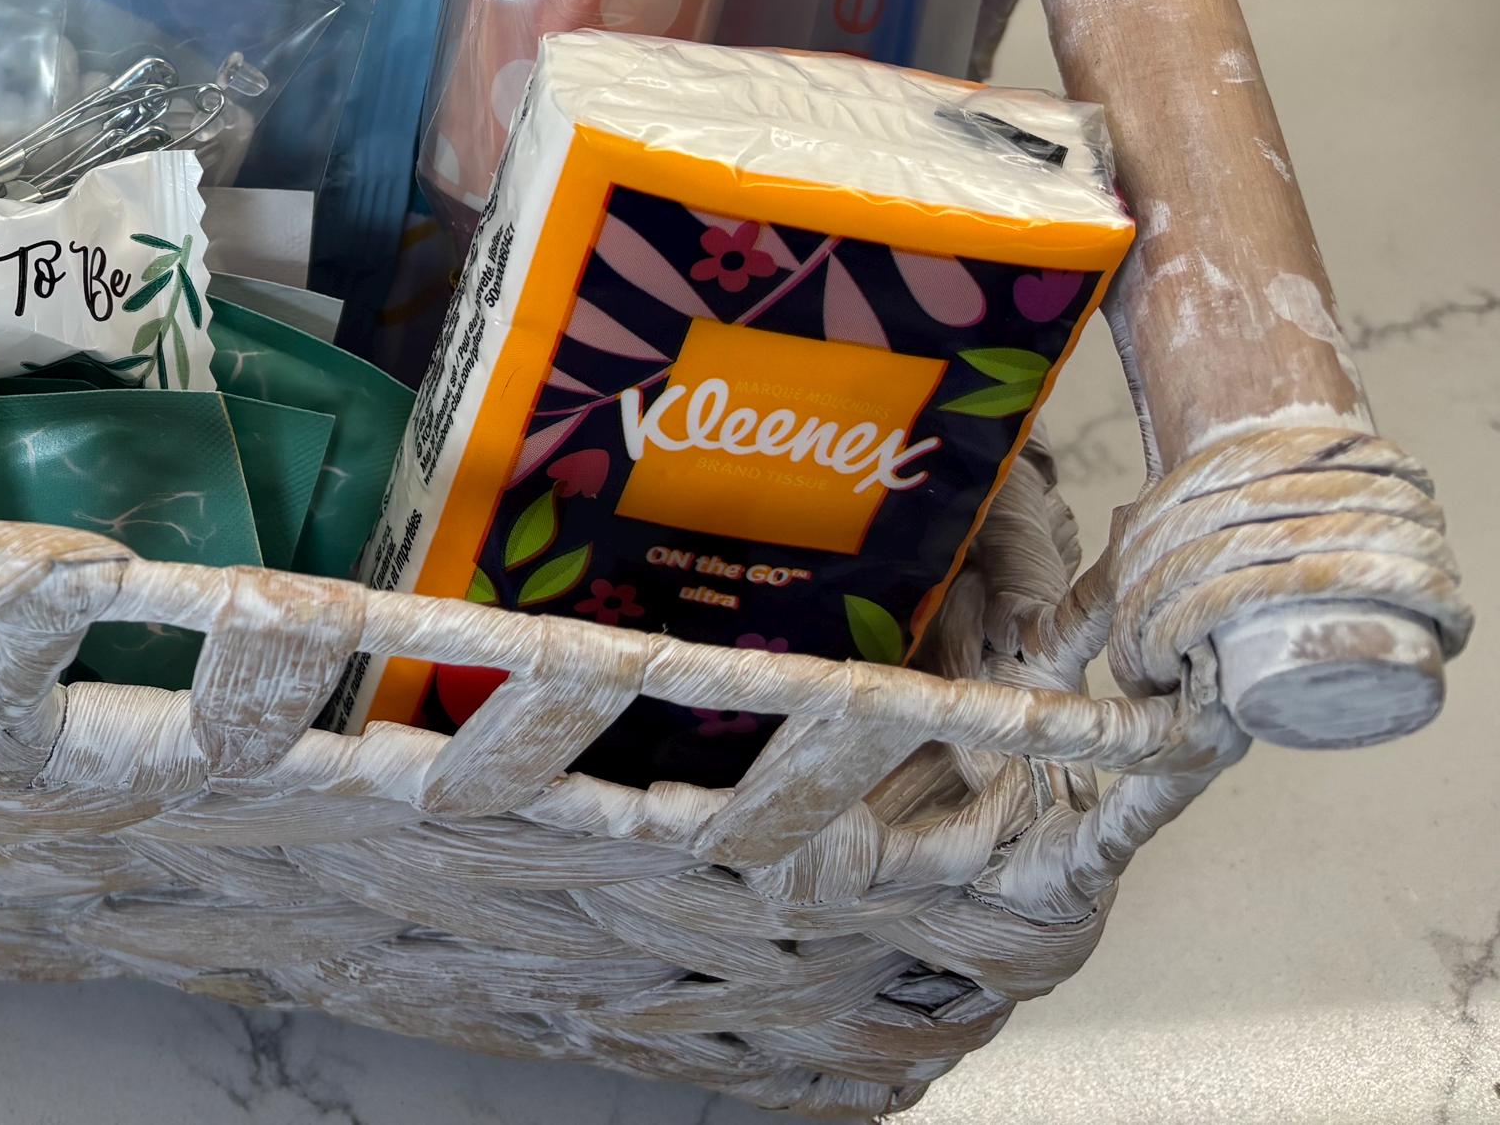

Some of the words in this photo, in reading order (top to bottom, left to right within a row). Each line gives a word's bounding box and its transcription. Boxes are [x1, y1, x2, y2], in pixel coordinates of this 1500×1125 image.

[69, 240, 132, 322] Be
[621, 378, 943, 493] Kleenex
[695, 456, 762, 480] BRAND
[764, 469, 830, 491] TISSUE
[646, 545, 694, 572] ON
[694, 555, 745, 580] the
[678, 585, 740, 610] ultra
